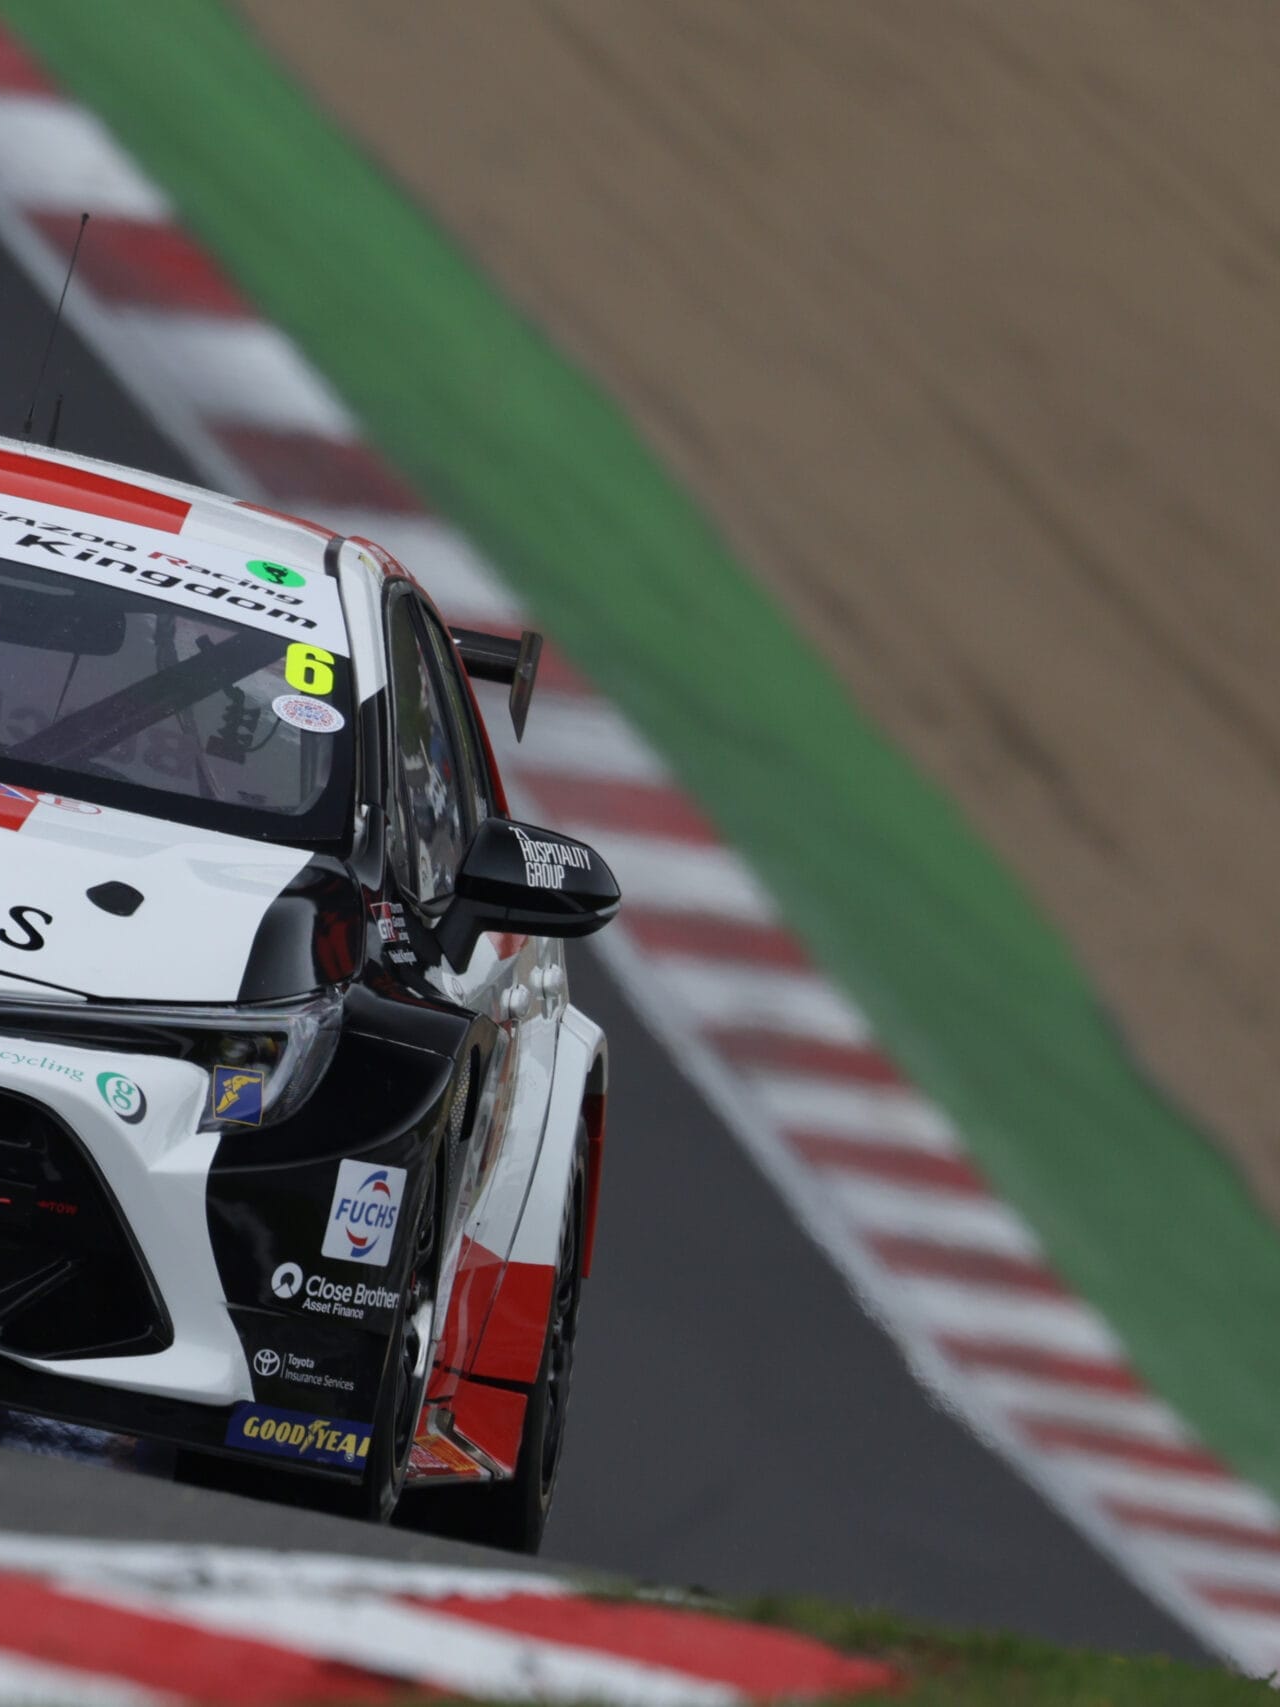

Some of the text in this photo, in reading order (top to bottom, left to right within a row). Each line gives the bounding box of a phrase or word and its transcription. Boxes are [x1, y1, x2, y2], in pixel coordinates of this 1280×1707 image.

[15, 534, 318, 630] Kingdom
[148, 552, 304, 606] Racing
[285, 642, 335, 696] 6
[518, 839, 592, 871] HOSPITALITY
[525, 862, 566, 890] GROUP
[49, 1199, 79, 1215] TOW
[336, 1197, 398, 1229] FUCHS
[305, 1274, 352, 1303] Close
[302, 1298, 364, 1320] Asset Finance
[288, 1353, 315, 1370] Toyota
[285, 1368, 355, 1392] Insurance Services
